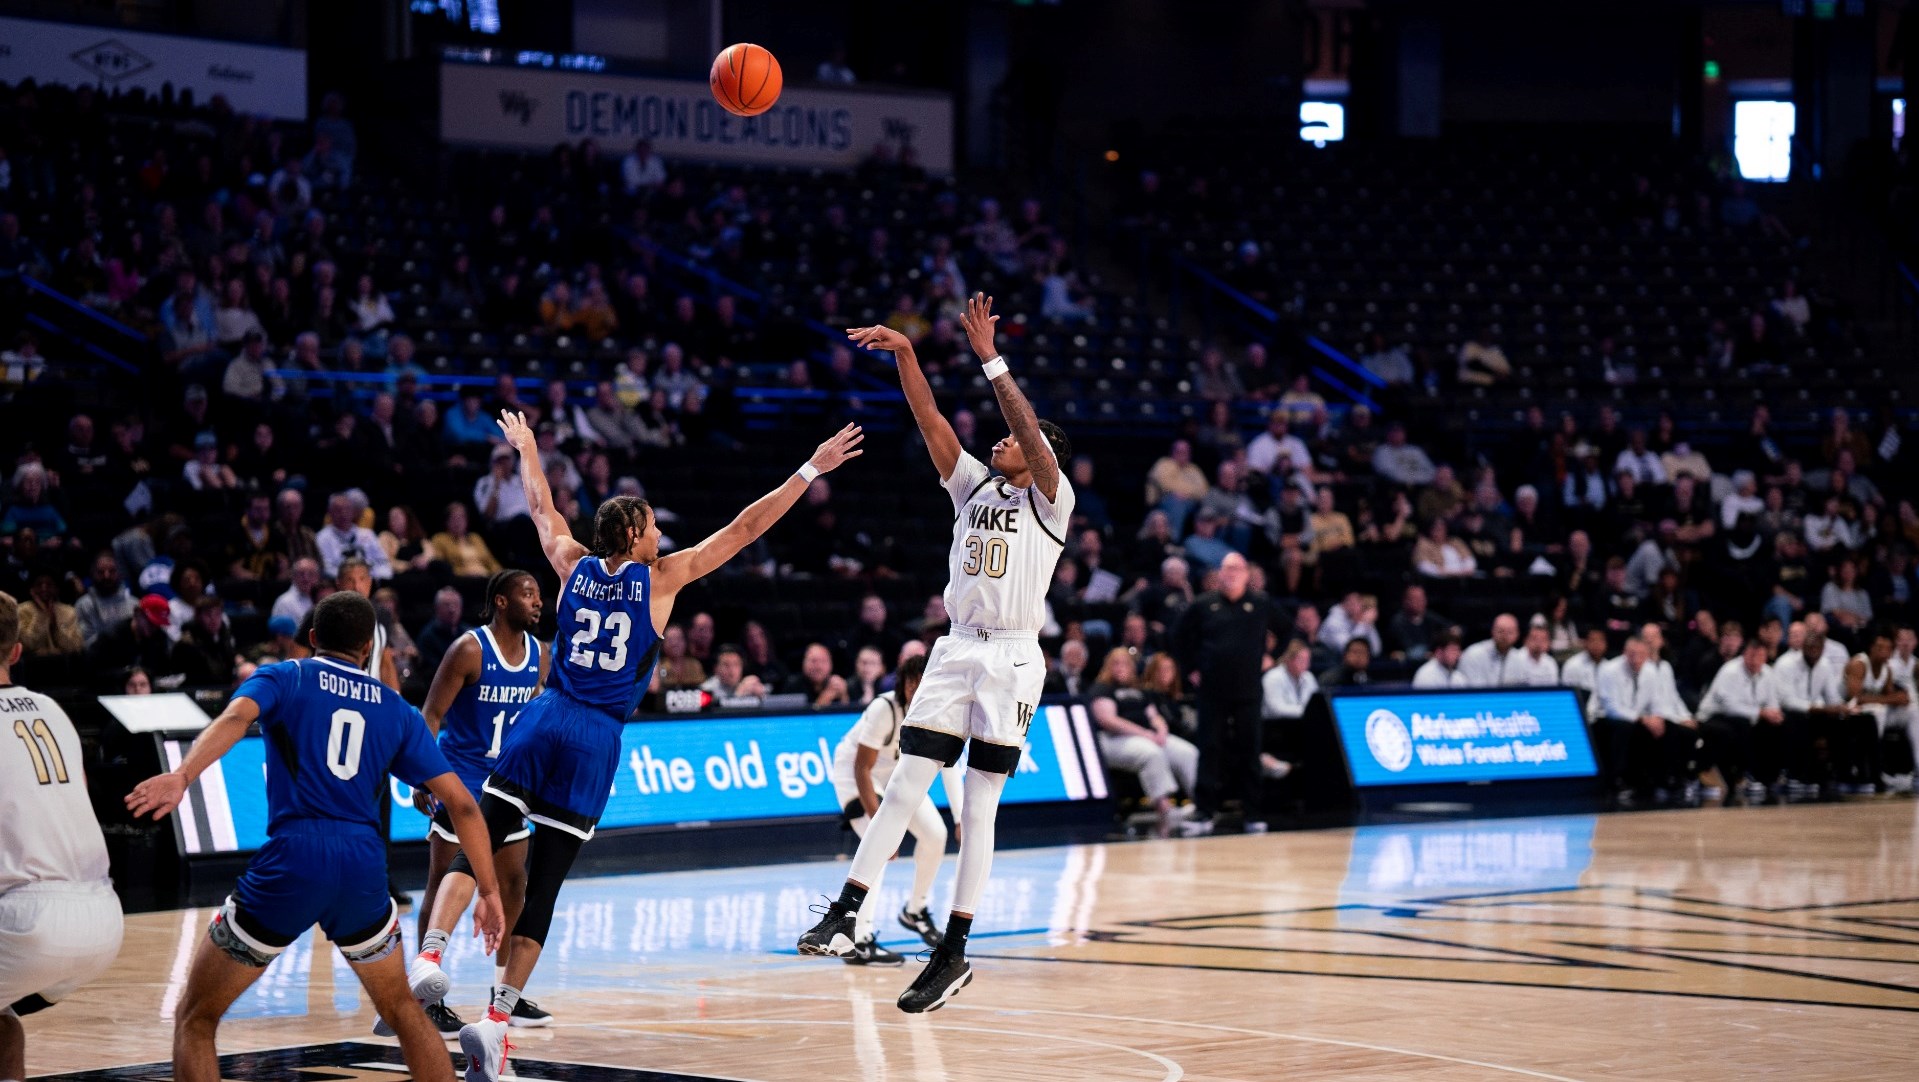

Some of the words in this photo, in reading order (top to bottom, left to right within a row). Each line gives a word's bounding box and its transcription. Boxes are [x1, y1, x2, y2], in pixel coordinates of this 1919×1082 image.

[565, 90, 687, 141] DEMON
[699, 98, 852, 151] DEACONS
[967, 504, 1019, 533] WAKE
[963, 534, 1009, 579] 30
[627, 580, 643, 602] JR
[568, 607, 632, 672] 23
[976, 628, 992, 642] WF
[0, 696, 40, 713] CARR
[318, 670, 382, 705] GODWIN
[477, 684, 537, 704] HAMPTO
[326, 707, 367, 781] 0
[484, 709, 522, 760] 1
[1411, 712, 1477, 741] Atrium
[1475, 710, 1542, 739] Health
[13, 718, 70, 785] 11
[629, 744, 697, 796] the
[704, 738, 769, 792] old
[775, 736, 836, 800] gol
